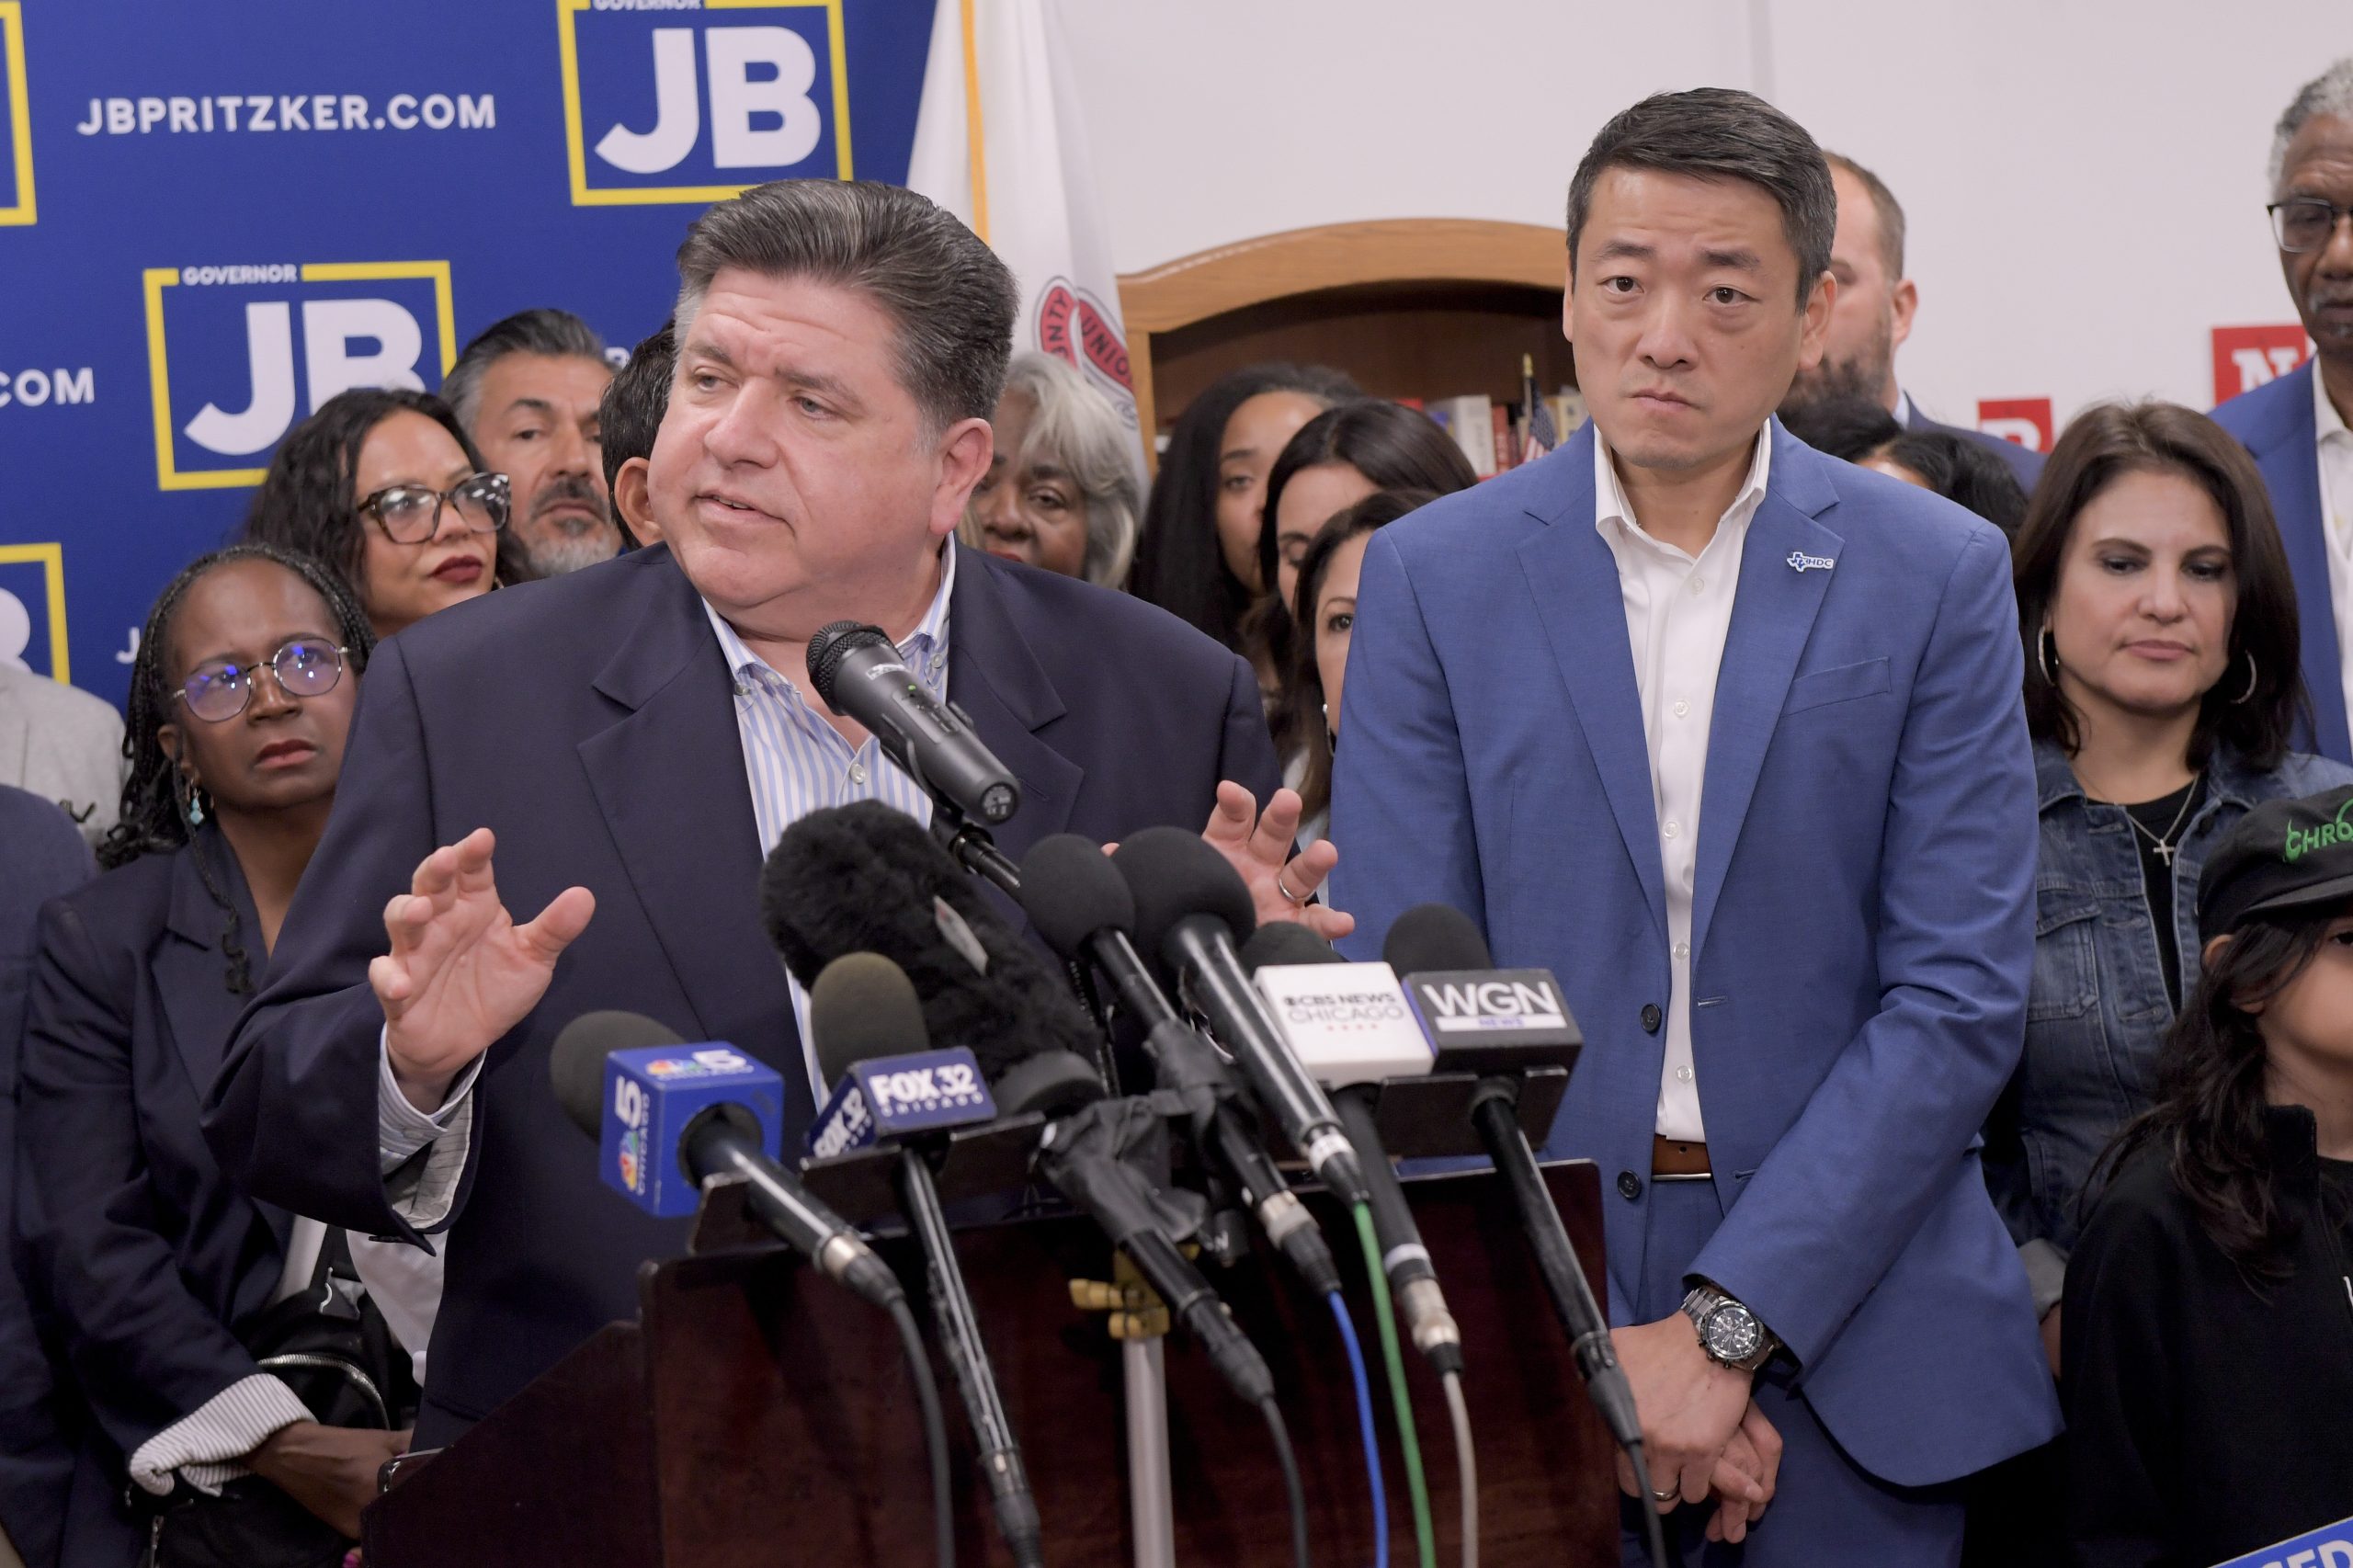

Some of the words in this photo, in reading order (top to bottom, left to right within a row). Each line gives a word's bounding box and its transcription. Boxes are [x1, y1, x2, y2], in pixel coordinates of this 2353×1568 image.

[76, 94, 496, 135] JBPRITZKER.COM
[594, 26, 822, 174] JB
[182, 264, 298, 286] GOVERNOR
[185, 298, 426, 455] JB
[1289, 1005, 1404, 1024] CHICAGO
[1300, 994, 1336, 1006] CBS
[1339, 992, 1396, 1004] NEWS
[1421, 981, 1563, 1016] WGN
[615, 1074, 642, 1130] 5
[869, 1068, 941, 1107] FOX
[936, 1063, 978, 1096] 32
